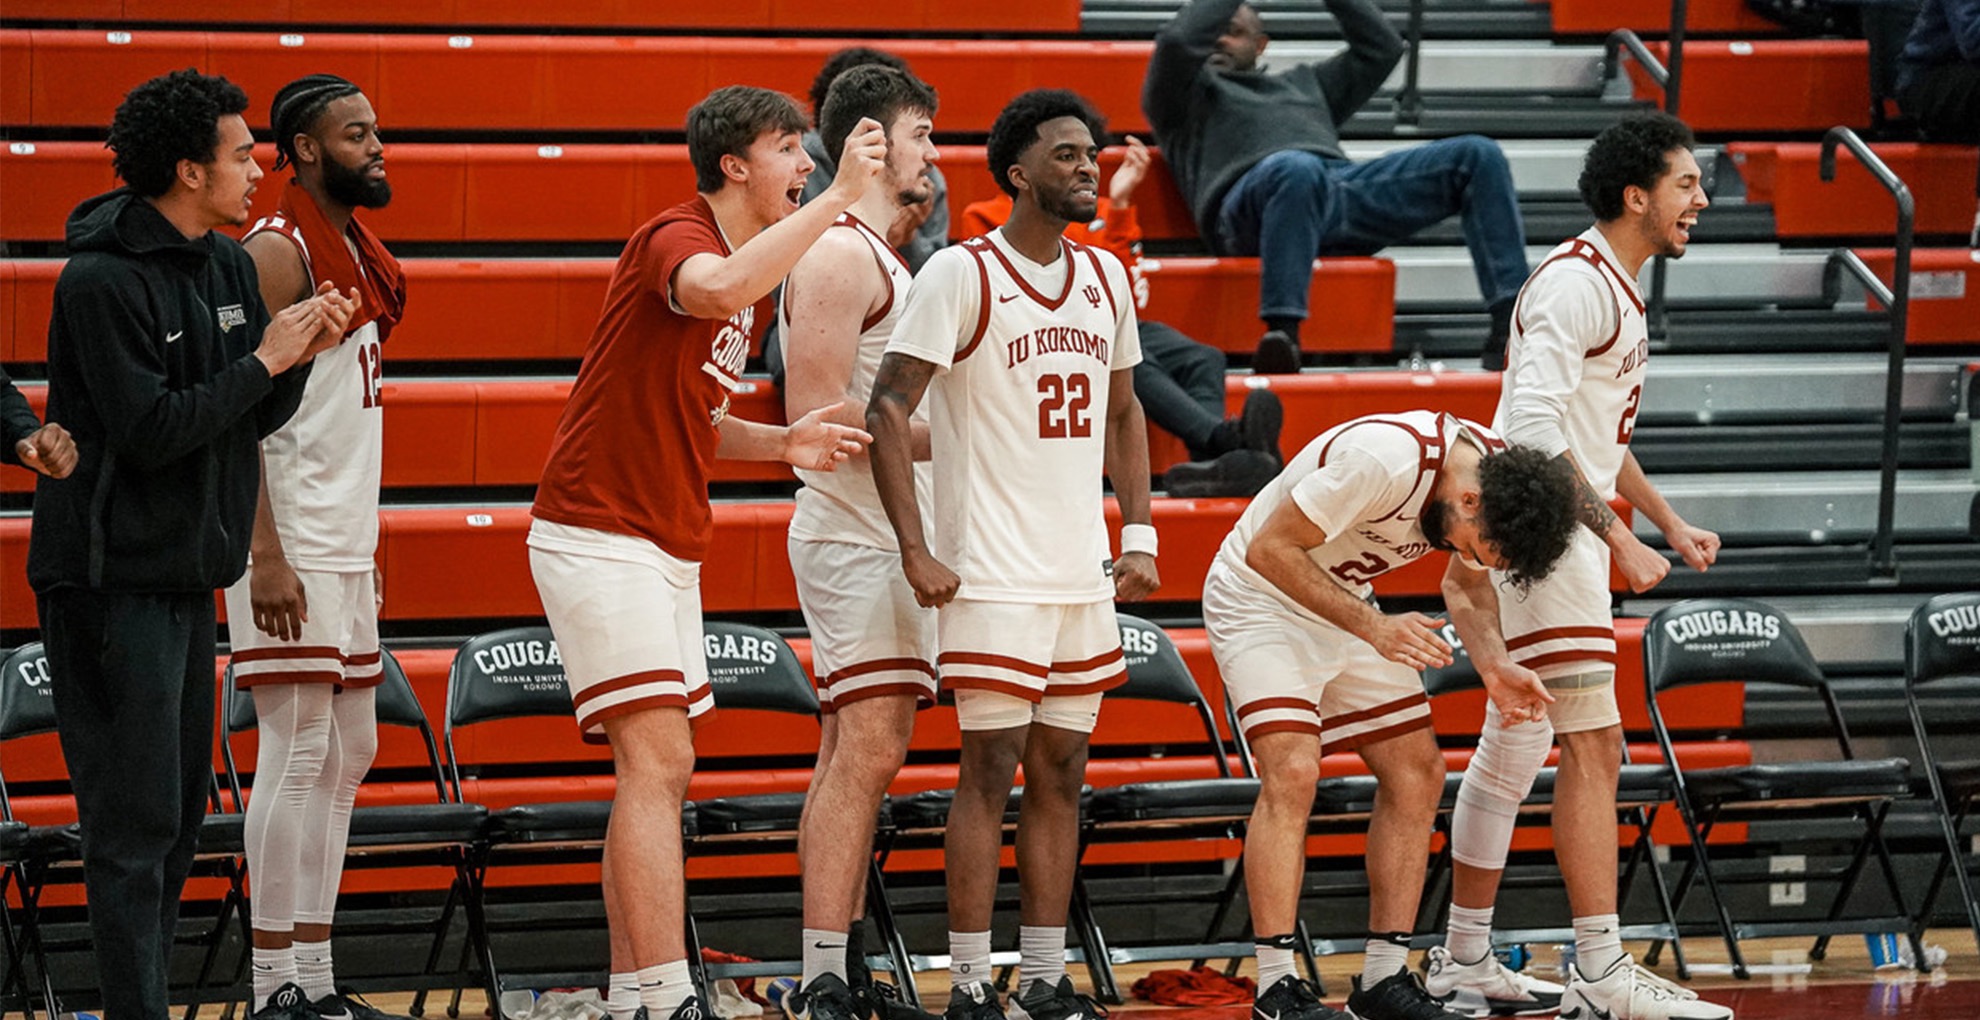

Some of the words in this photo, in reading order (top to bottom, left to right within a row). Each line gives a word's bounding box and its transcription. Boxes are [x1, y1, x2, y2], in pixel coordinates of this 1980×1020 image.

[1007, 334, 1029, 369] IU
[1034, 327, 1109, 366] KOKOMO
[358, 342, 382, 409] 12
[1037, 373, 1091, 438] 22
[1328, 551, 1389, 586] 2
[1664, 610, 1780, 644] COUGARS
[1928, 604, 1980, 637] COU
[703, 634, 778, 665] GARS
[1121, 626, 1158, 655] RS
[18, 656, 51, 687] CO
[474, 640, 563, 675] COUGA
[711, 665, 766, 676] UNIVERSITY
[492, 675, 532, 684] INDIANA
[523, 682, 561, 691] KOKOMO
